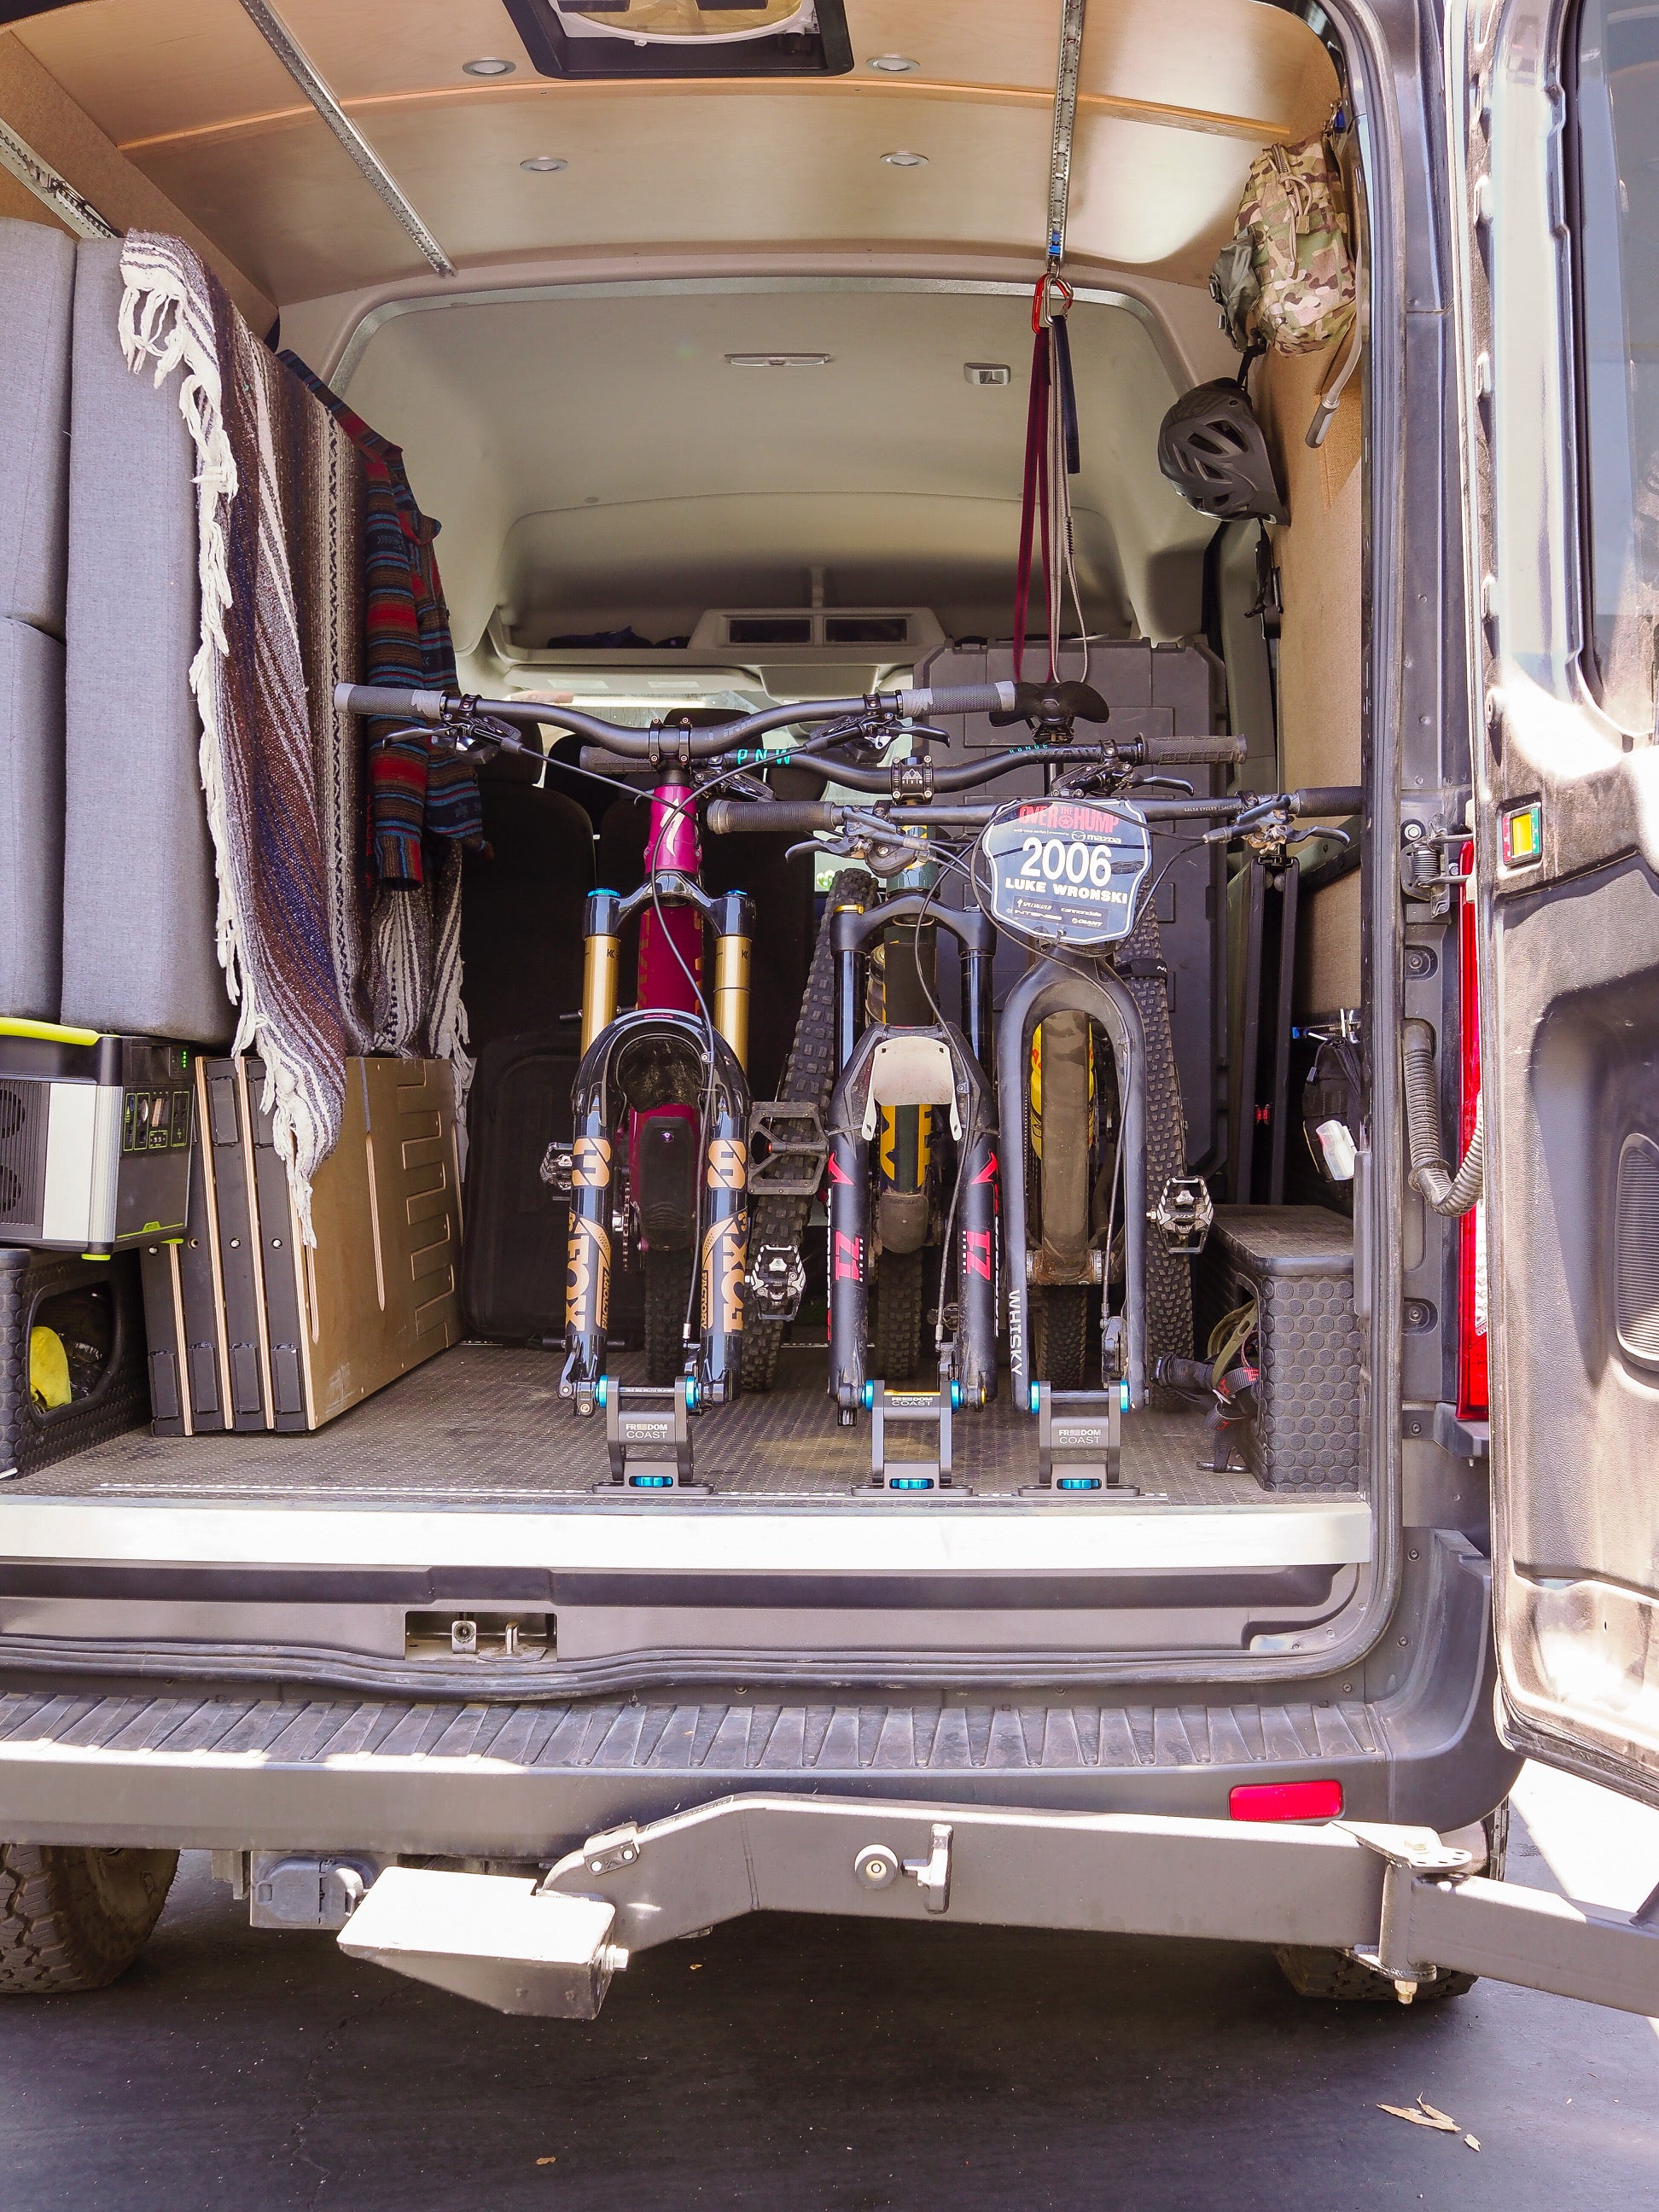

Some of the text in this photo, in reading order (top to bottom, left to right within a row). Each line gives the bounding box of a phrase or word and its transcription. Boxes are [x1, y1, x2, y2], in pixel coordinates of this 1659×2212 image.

[1019, 805, 1120, 834] OVER THE HUMP
[1020, 836, 1113, 888] 2006
[1004, 877, 1128, 905] LUKE WRONSKI
[1078, 917, 1103, 927] GIANT
[835, 1230, 861, 1281] Z1
[965, 1230, 992, 1281] Z1
[565, 1235, 590, 1332] FOX
[720, 1236, 748, 1333] FOX
[1008, 1289, 1024, 1377] WHISKY
[626, 1430, 668, 1440] COAST
[1059, 1436, 1102, 1445] COAST
